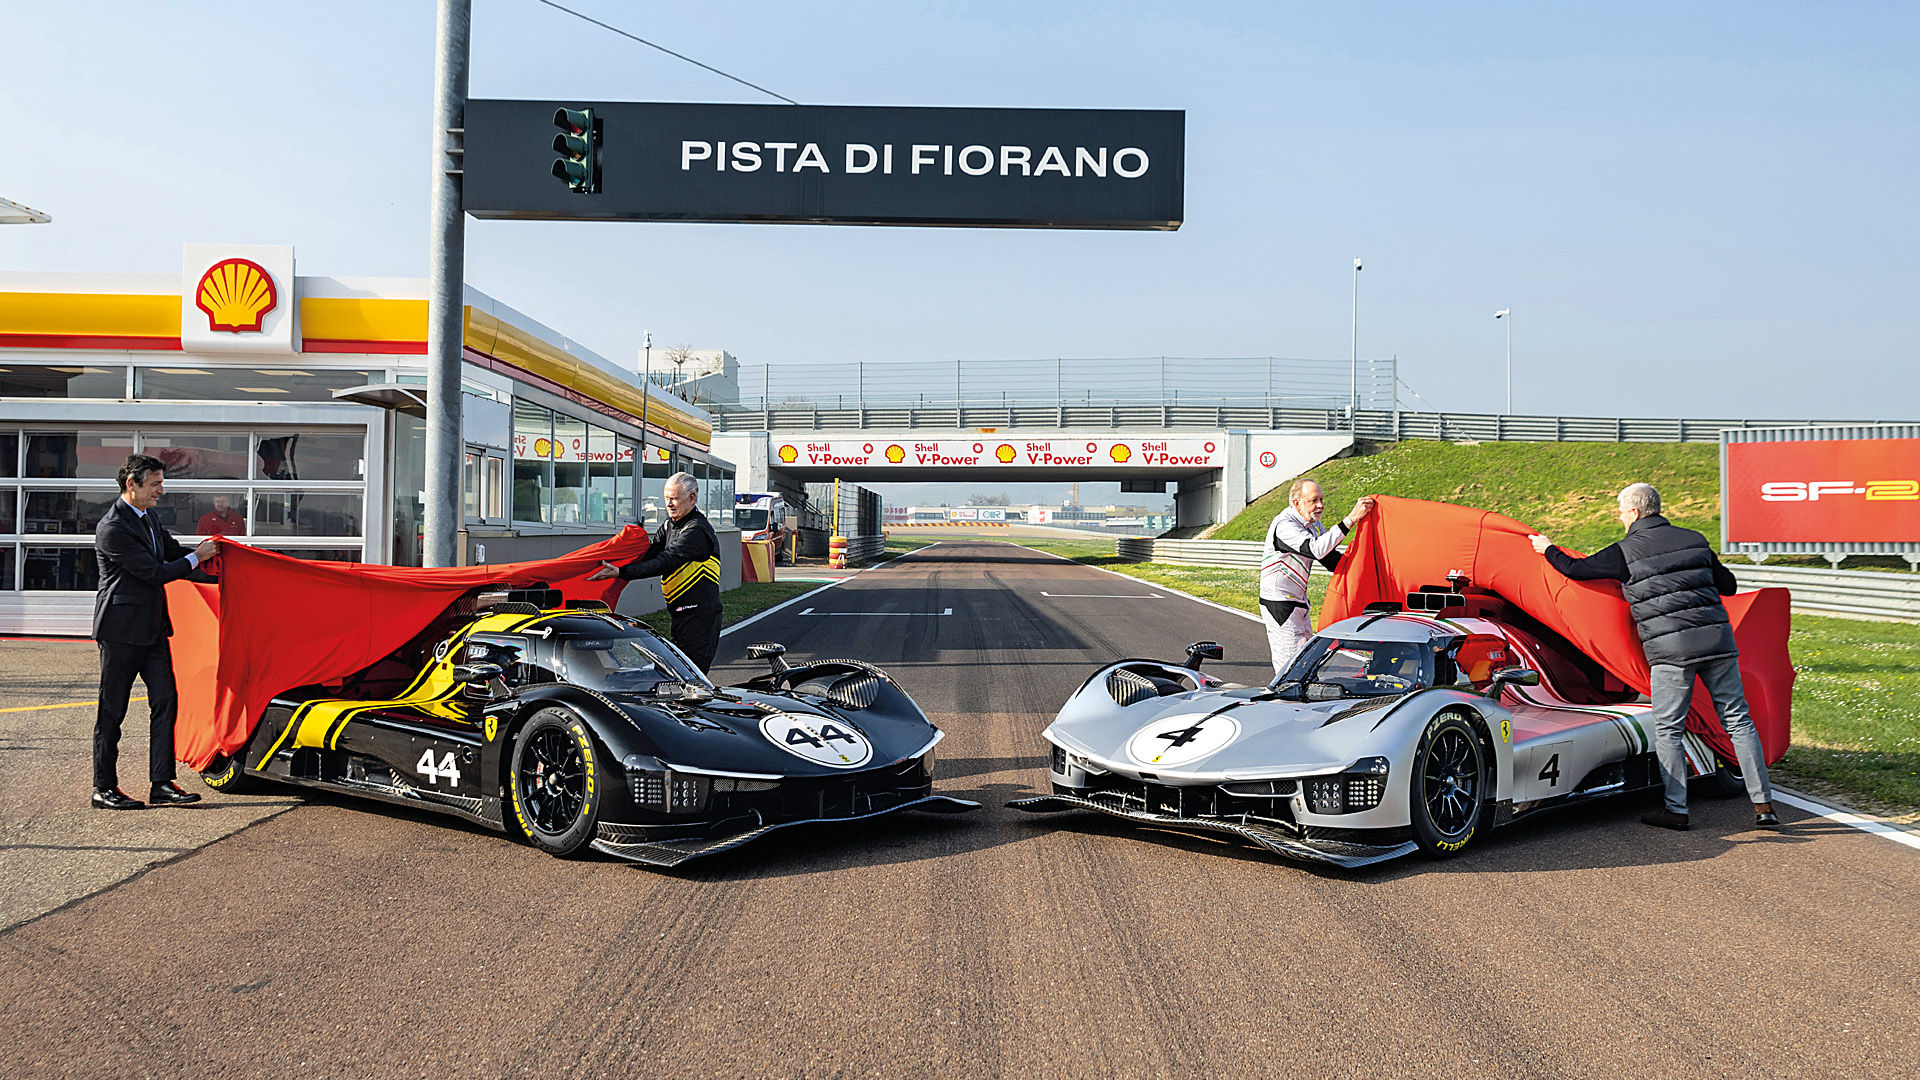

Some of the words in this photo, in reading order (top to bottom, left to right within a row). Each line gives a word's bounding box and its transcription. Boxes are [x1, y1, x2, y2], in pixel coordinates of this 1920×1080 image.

[681, 140, 830, 173] PISTA
[845, 143, 893, 174] DI
[911, 144, 1150, 178] FIORANO
[807, 443, 830, 452] Shell
[914, 443, 939, 452] Shell
[1026, 443, 1051, 452] Shell
[1141, 442, 1167, 451] Shell
[808, 453, 870, 465] V-Power
[916, 453, 980, 465] V-Power
[1027, 453, 1093, 465] V-Power
[1142, 453, 1210, 465] V-Power
[1761, 480, 1920, 501] SF-2
[785, 724, 857, 749] 44
[1156, 726, 1204, 747] 4
[416, 748, 461, 787] 44
[1538, 753, 1560, 787] 4
[1436, 826, 1475, 851] PIRELLI
